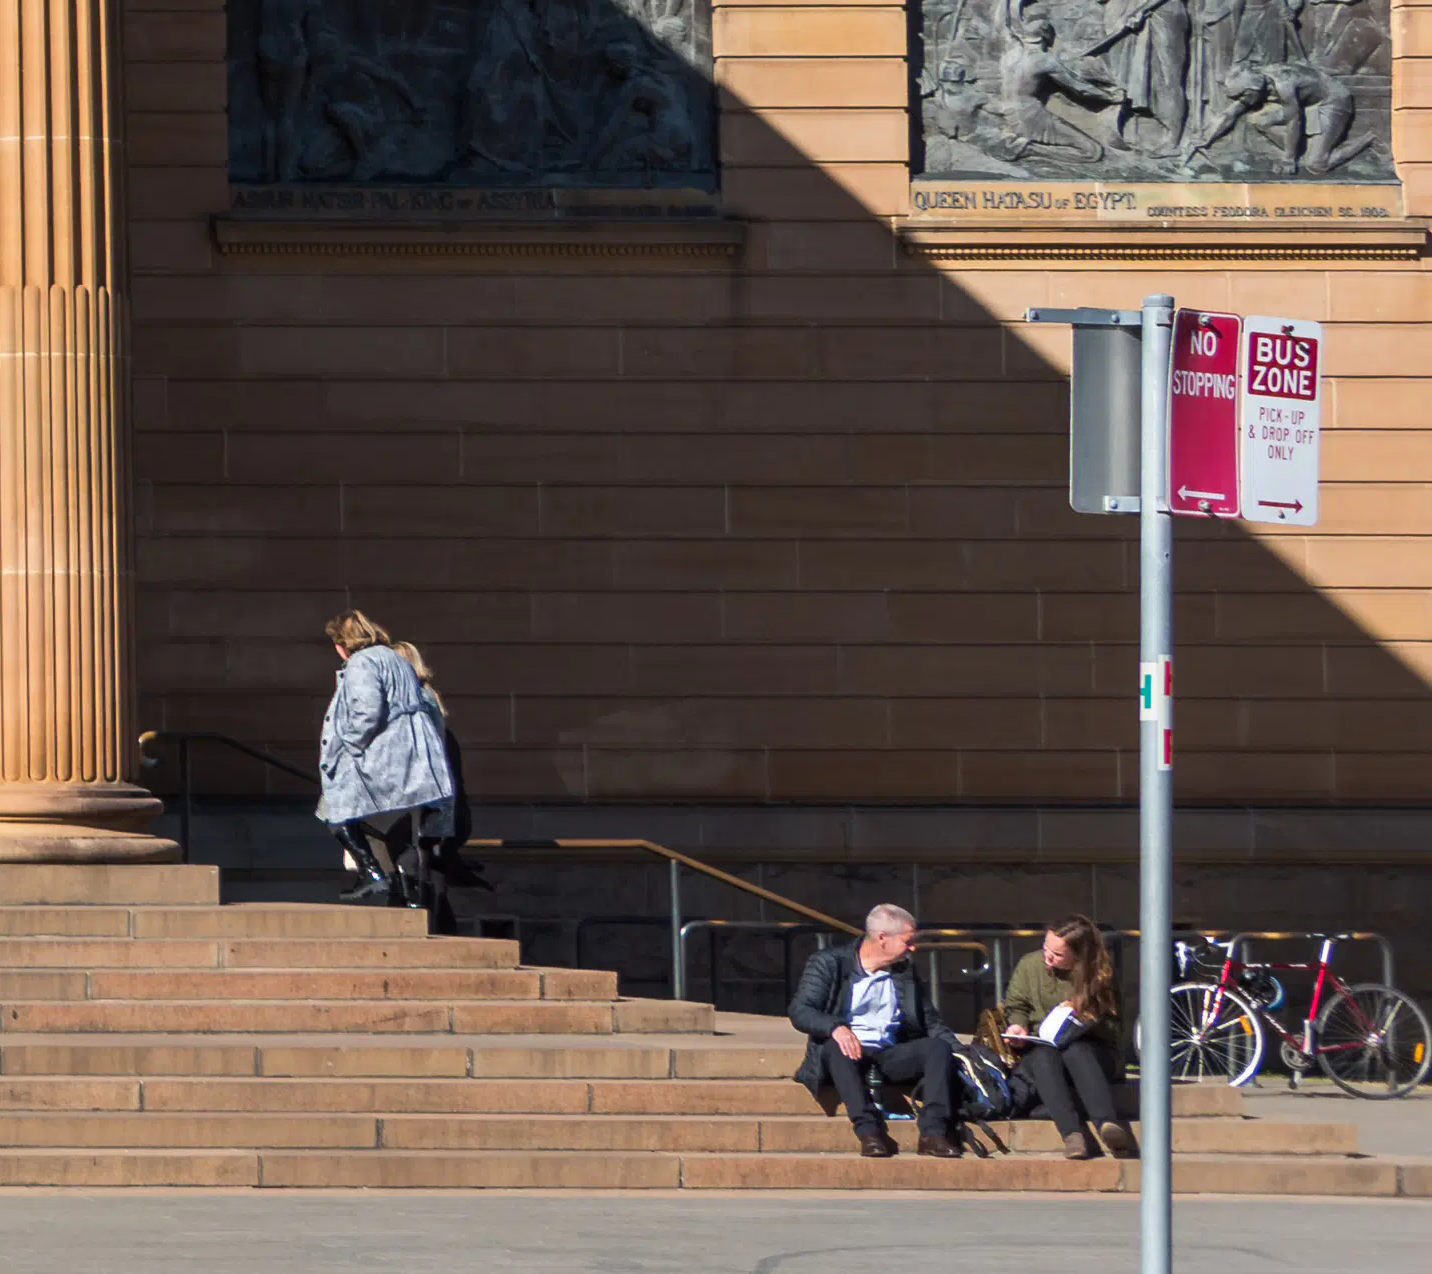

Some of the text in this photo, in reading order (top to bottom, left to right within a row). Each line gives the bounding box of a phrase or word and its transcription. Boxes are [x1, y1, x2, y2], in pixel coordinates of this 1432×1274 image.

[914, 191, 977, 211] QUEEN
[982, 191, 1053, 209] HATASU
[1190, 330, 1217, 356] NO
[1256, 336, 1310, 367] BUS
[1172, 370, 1236, 400] STOPPING
[1252, 365, 1313, 396] ZONE
[1248, 424, 1315, 445] & DROP OFF
[1267, 444, 1294, 461] ONLY
